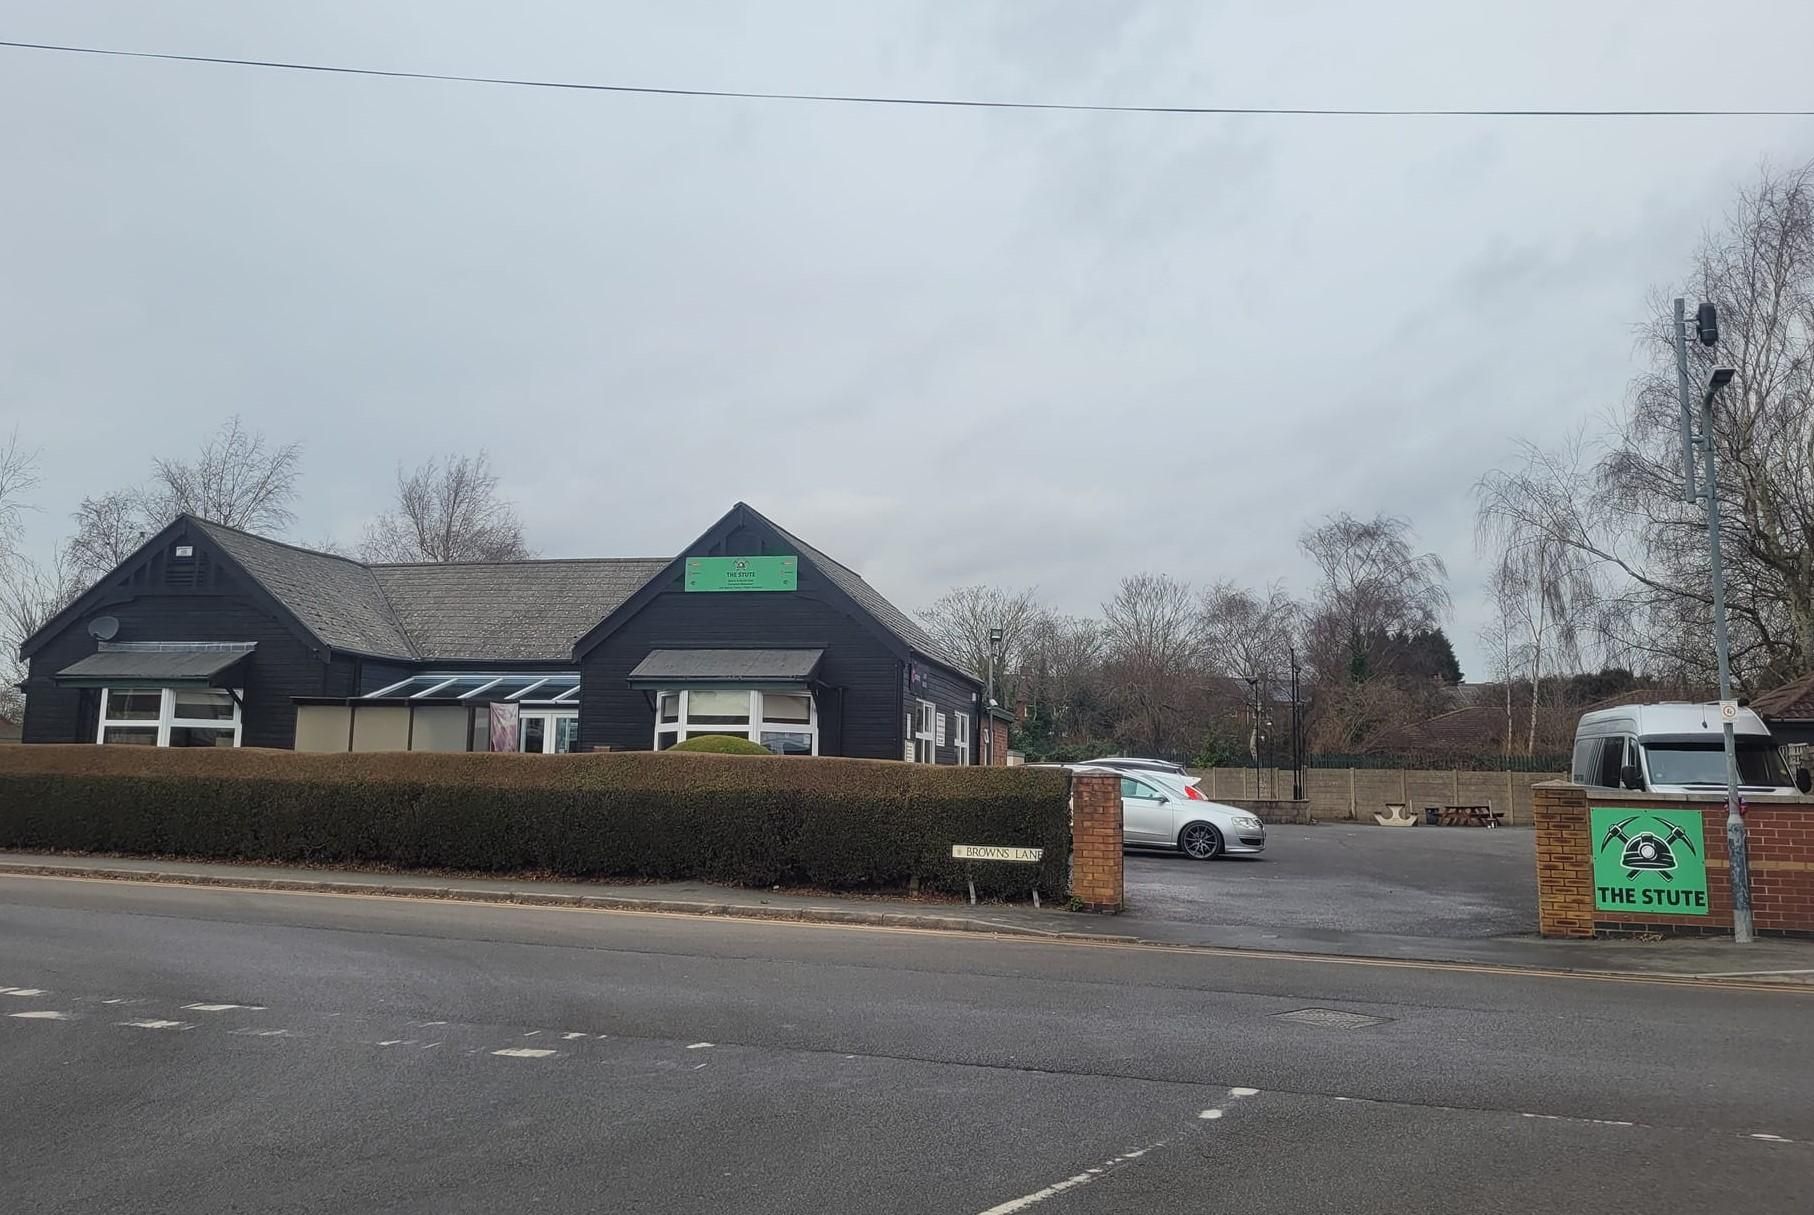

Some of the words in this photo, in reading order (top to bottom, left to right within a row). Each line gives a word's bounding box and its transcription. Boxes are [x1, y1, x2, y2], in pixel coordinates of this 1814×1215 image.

[966, 847, 1010, 859] BROWNS
[1598, 886, 1637, 904] THE
[1641, 888, 1706, 907] STUTE
